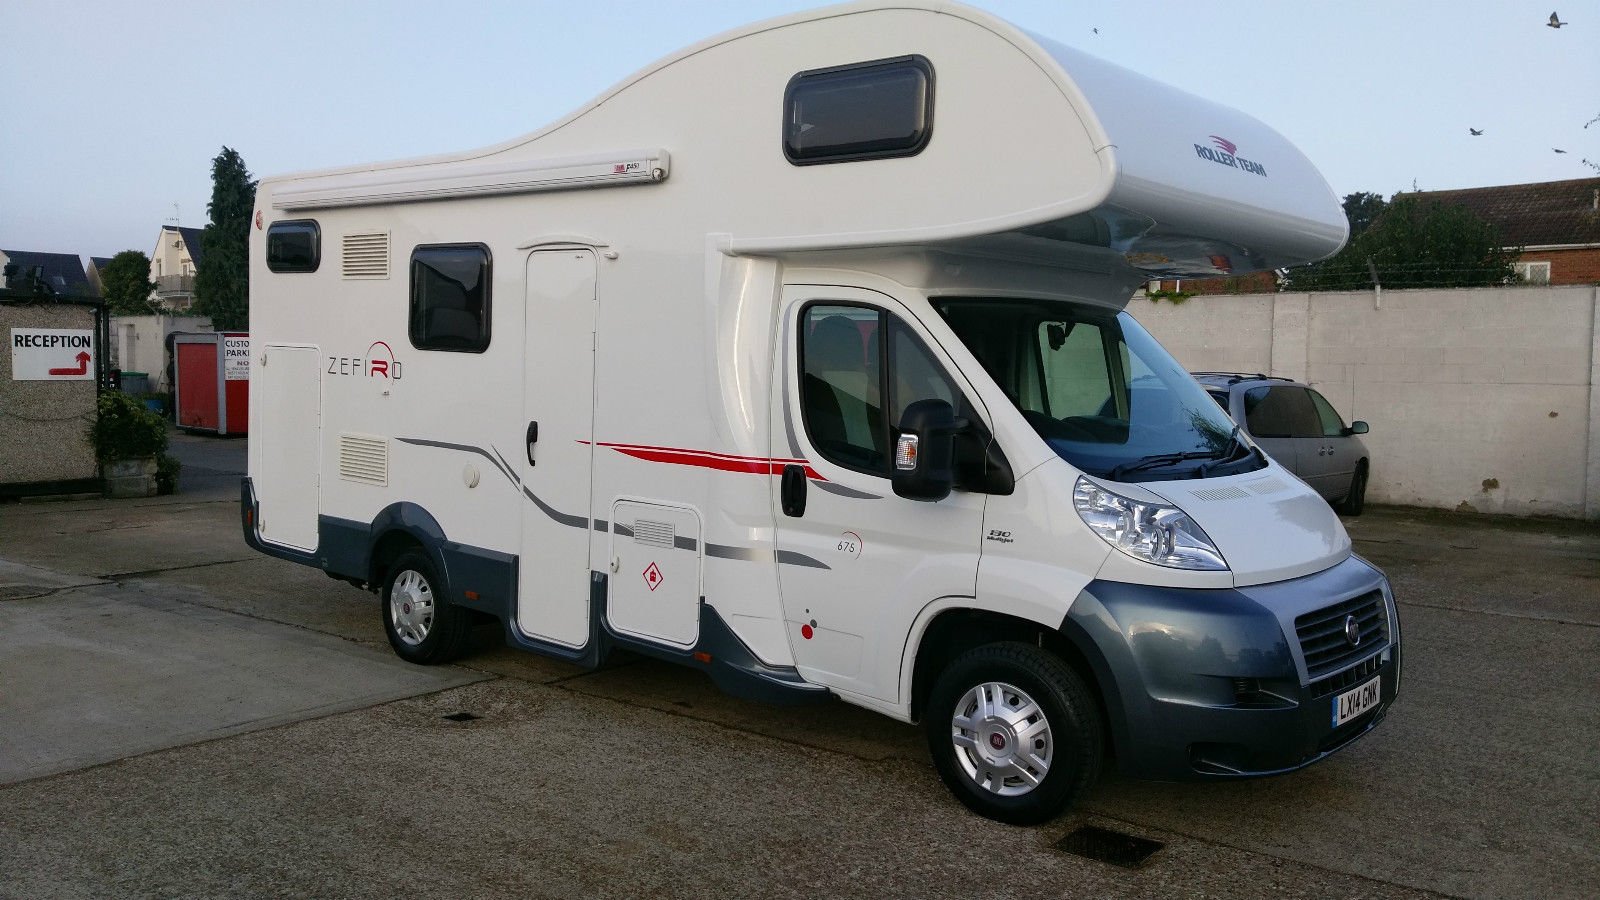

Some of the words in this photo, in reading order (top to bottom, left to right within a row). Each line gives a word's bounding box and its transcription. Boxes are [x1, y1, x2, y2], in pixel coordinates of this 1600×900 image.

[1193, 143, 1239, 169] ROLLER
[1236, 156, 1267, 177] TEAM
[14, 334, 91, 349] RECEPTION
[327, 356, 402, 380] ZEFIRO
[989, 529, 1012, 538] 130
[1340, 690, 1361, 720] LX14
[1362, 680, 1378, 708] GNK
